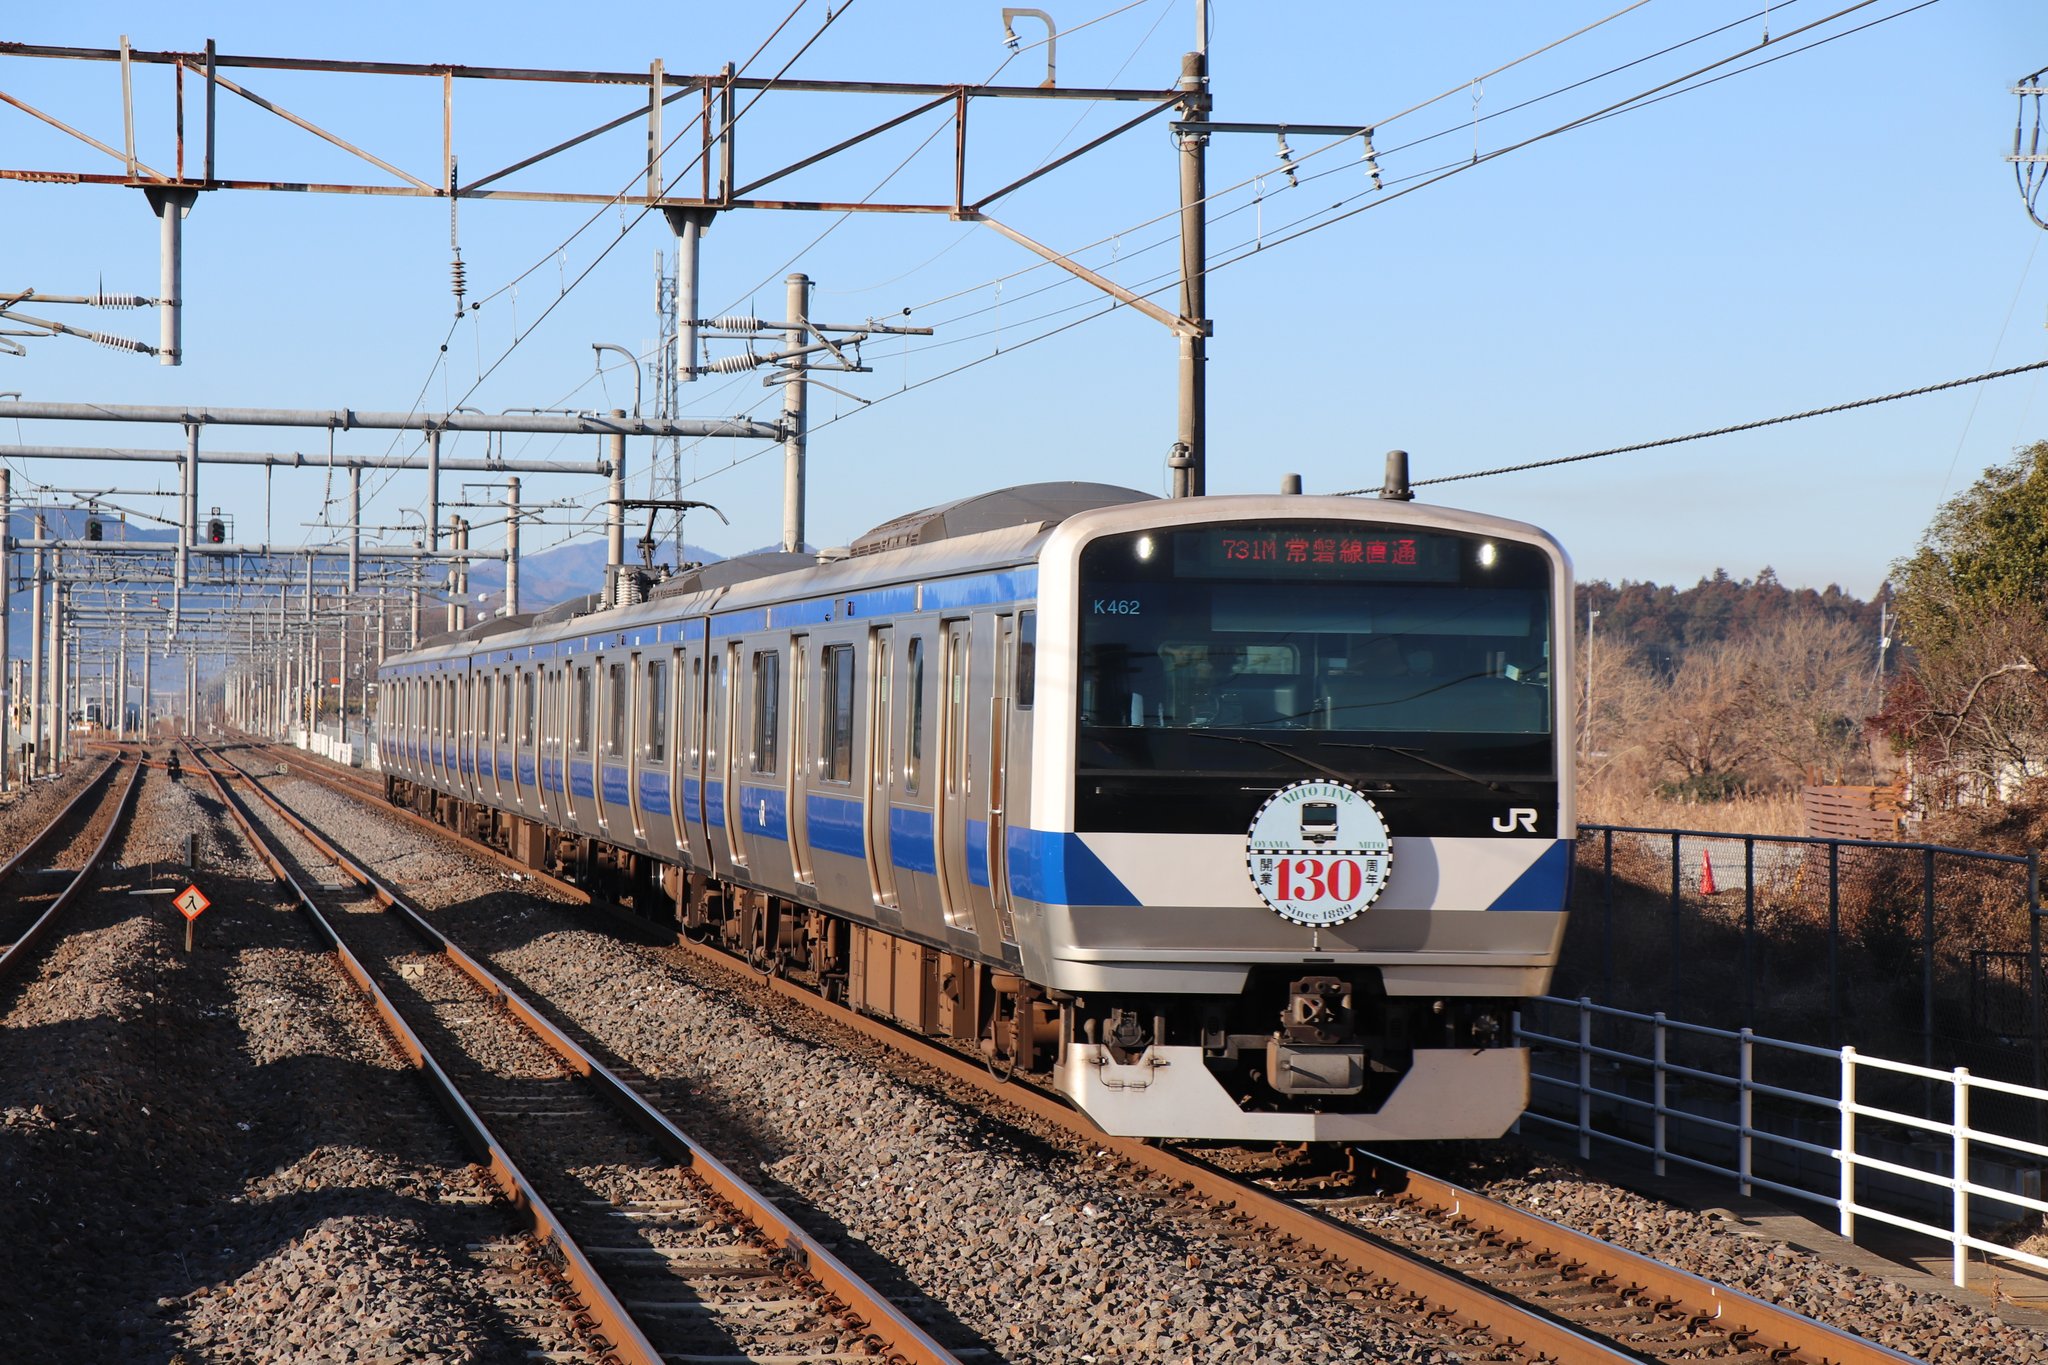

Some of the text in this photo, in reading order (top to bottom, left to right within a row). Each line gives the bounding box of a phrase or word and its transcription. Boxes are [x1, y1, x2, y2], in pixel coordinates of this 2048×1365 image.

[1222, 538, 1416, 564] 731M 常磐線直通
[1094, 599, 1140, 614] K462
[1282, 787, 1356, 805] MITO LINE
[1492, 808, 1538, 833] JR
[1359, 841, 1384, 849] MITO
[1260, 858, 1272, 886] 開業
[1273, 858, 1362, 902] 130
[1365, 859, 1378, 886] 周年
[1284, 903, 1352, 920] Since 1889
